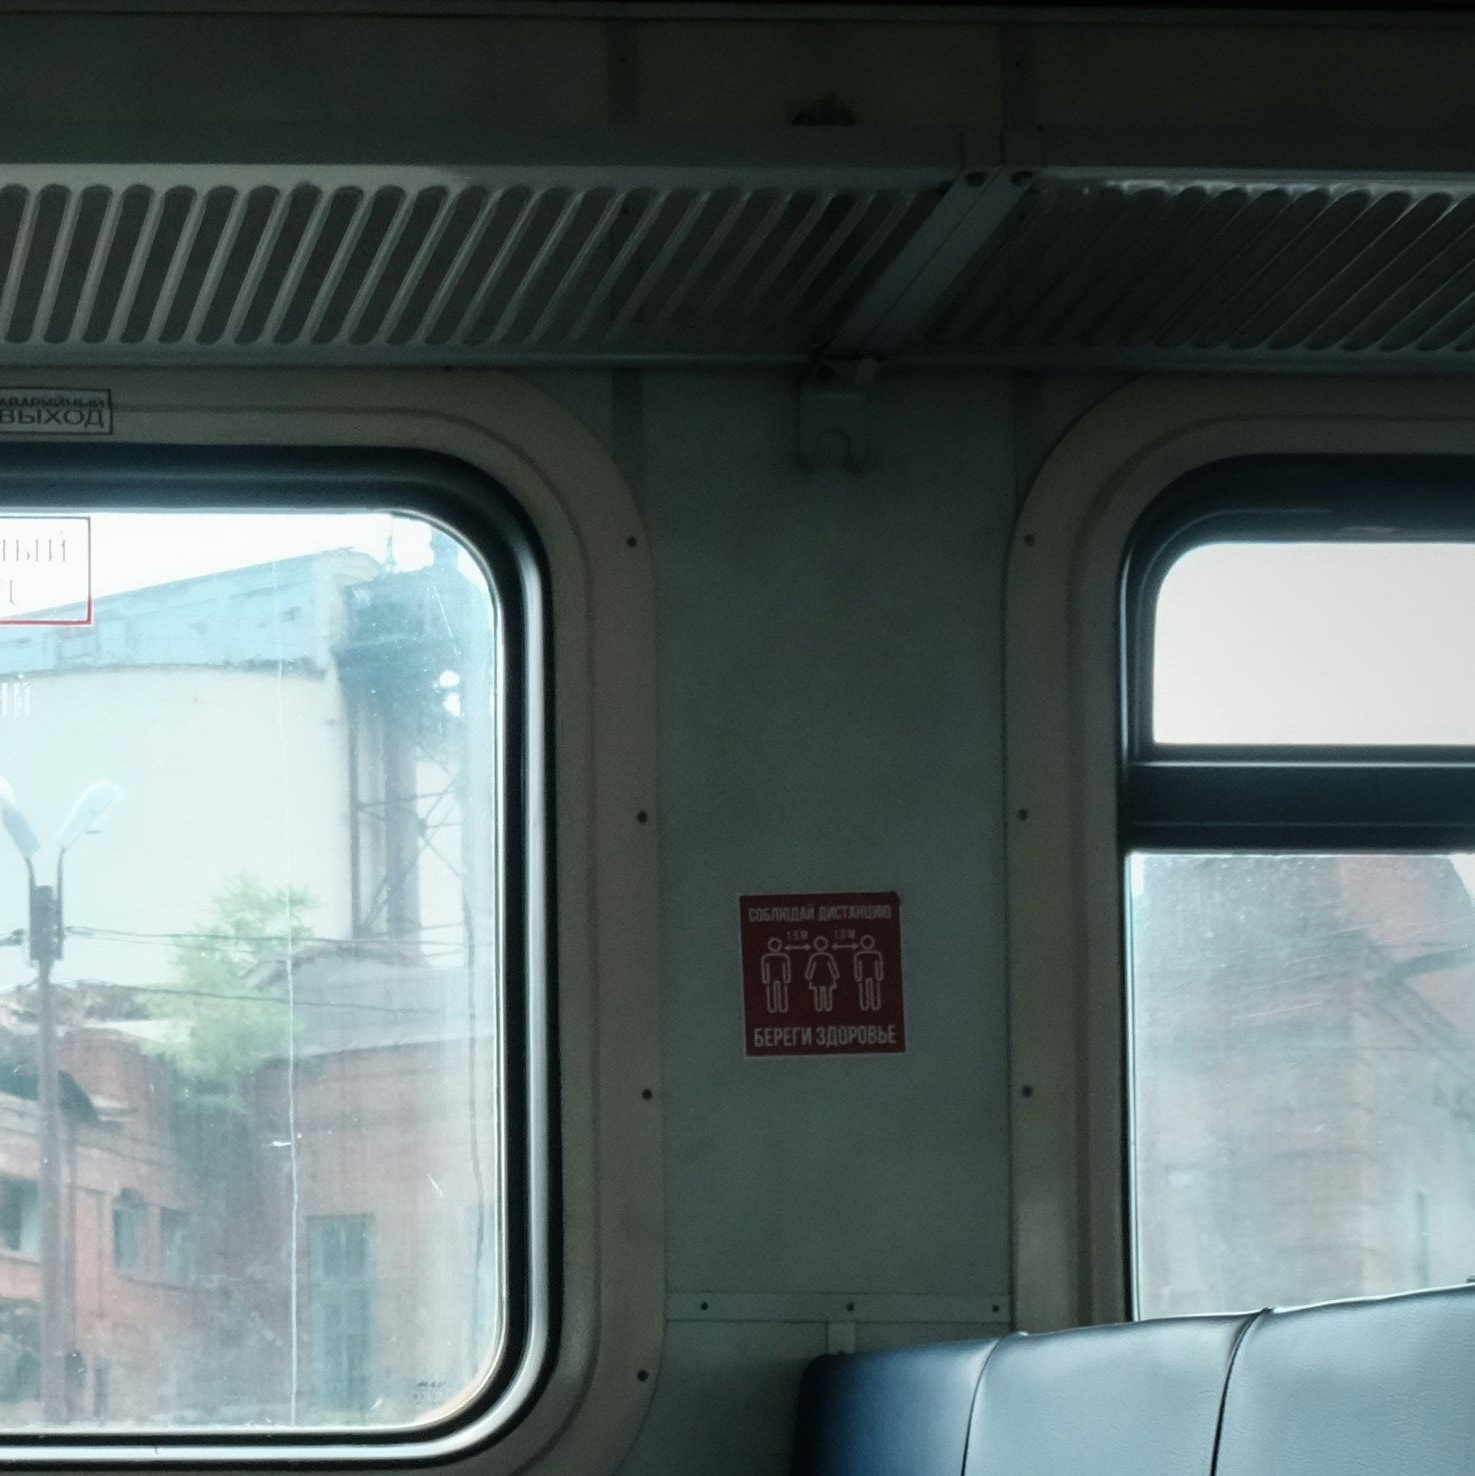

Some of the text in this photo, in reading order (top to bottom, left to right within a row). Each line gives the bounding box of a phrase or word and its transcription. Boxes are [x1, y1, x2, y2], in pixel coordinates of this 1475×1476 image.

[748, 904, 892, 923] СОБЛЮДАЙ ДИСТАНЦИЮ
[754, 1024, 897, 1047] БЕРЕГИ ЗДОРОВЬЕ
